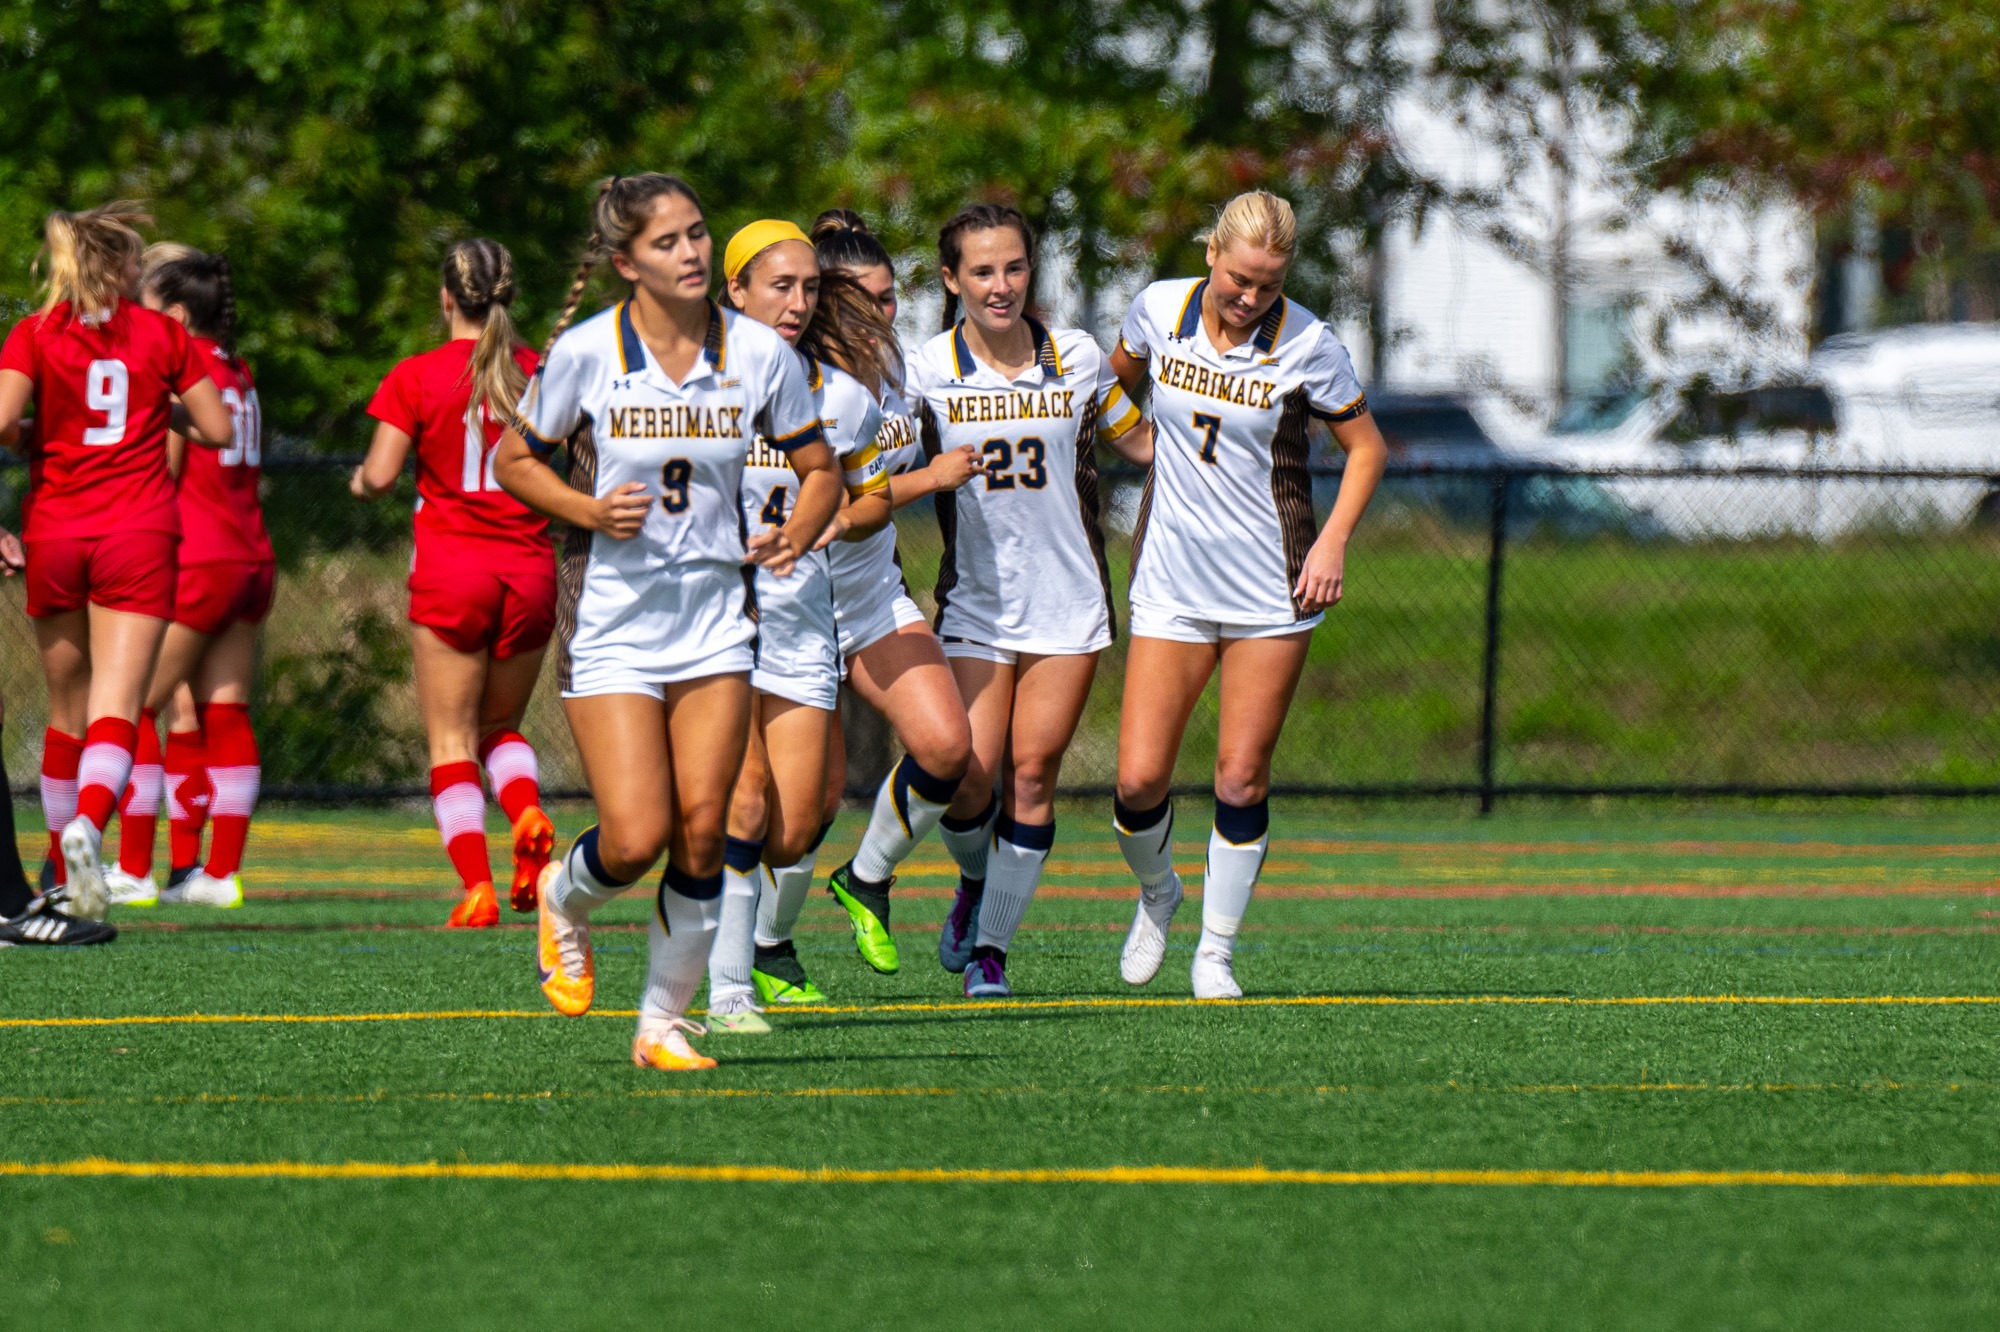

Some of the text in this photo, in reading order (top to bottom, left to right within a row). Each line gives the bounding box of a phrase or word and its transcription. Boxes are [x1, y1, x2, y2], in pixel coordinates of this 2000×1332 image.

[83, 359, 129, 446] 9
[947, 390, 1075, 424] MERRIMACK
[1158, 354, 1277, 410] MERRIMACK
[609, 404, 744, 439] MERRIMACK
[1192, 411, 1222, 465] 7
[661, 456, 693, 515] 9
[981, 436, 1048, 491] 23
[760, 484, 788, 528] 4
